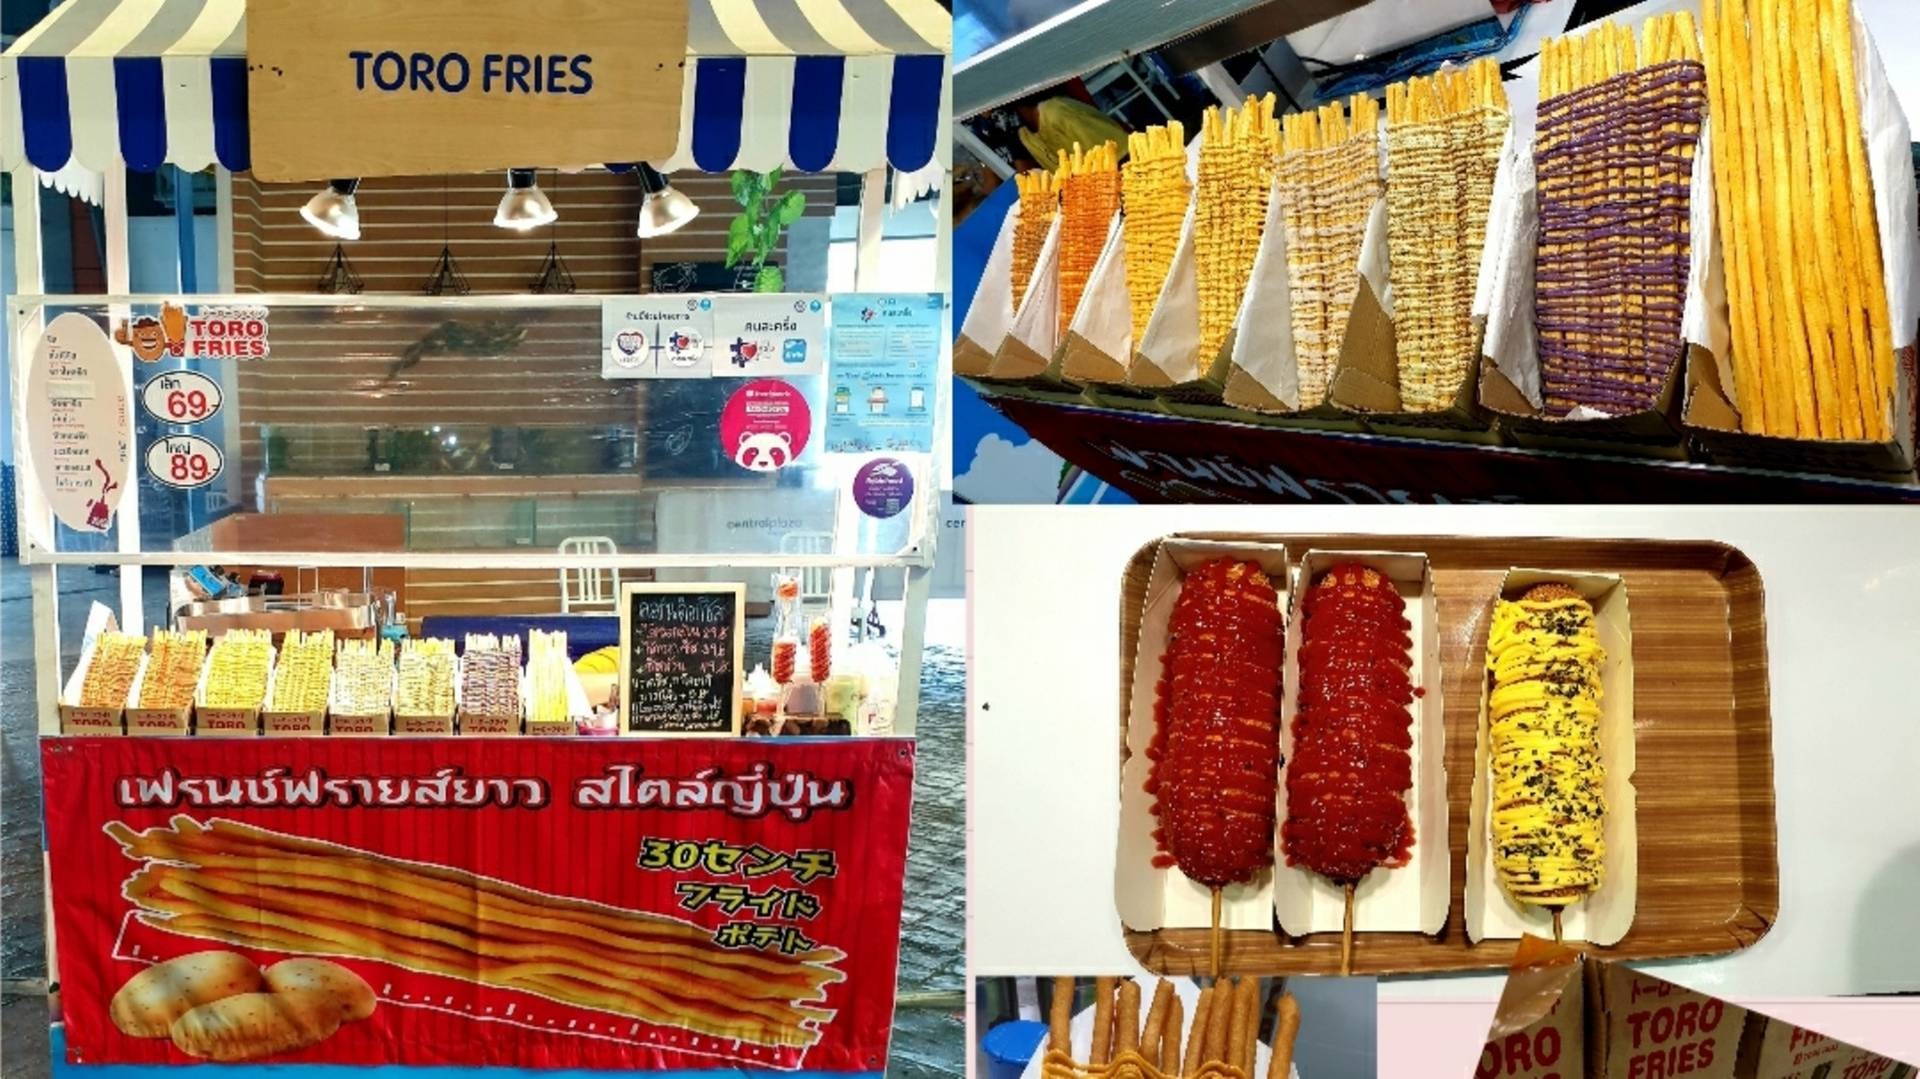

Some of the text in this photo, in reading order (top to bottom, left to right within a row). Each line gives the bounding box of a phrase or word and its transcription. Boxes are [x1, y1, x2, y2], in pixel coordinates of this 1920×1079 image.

[349, 51, 593, 94] TORO FRIES
[190, 320, 264, 337] TORO
[192, 340, 266, 356] FRIES
[160, 376, 181, 390] เล็ก
[119, 763, 847, 819] เฟรนช์ฟรายส์ยาว สไตล์ญี่ปุ่น
[640, 838, 837, 883] 30センチ
[677, 883, 821, 919] フライド
[714, 921, 815, 955] ポテト
[1627, 997, 1724, 1049] TORO
[1628, 1038, 1717, 1079] FRIES
